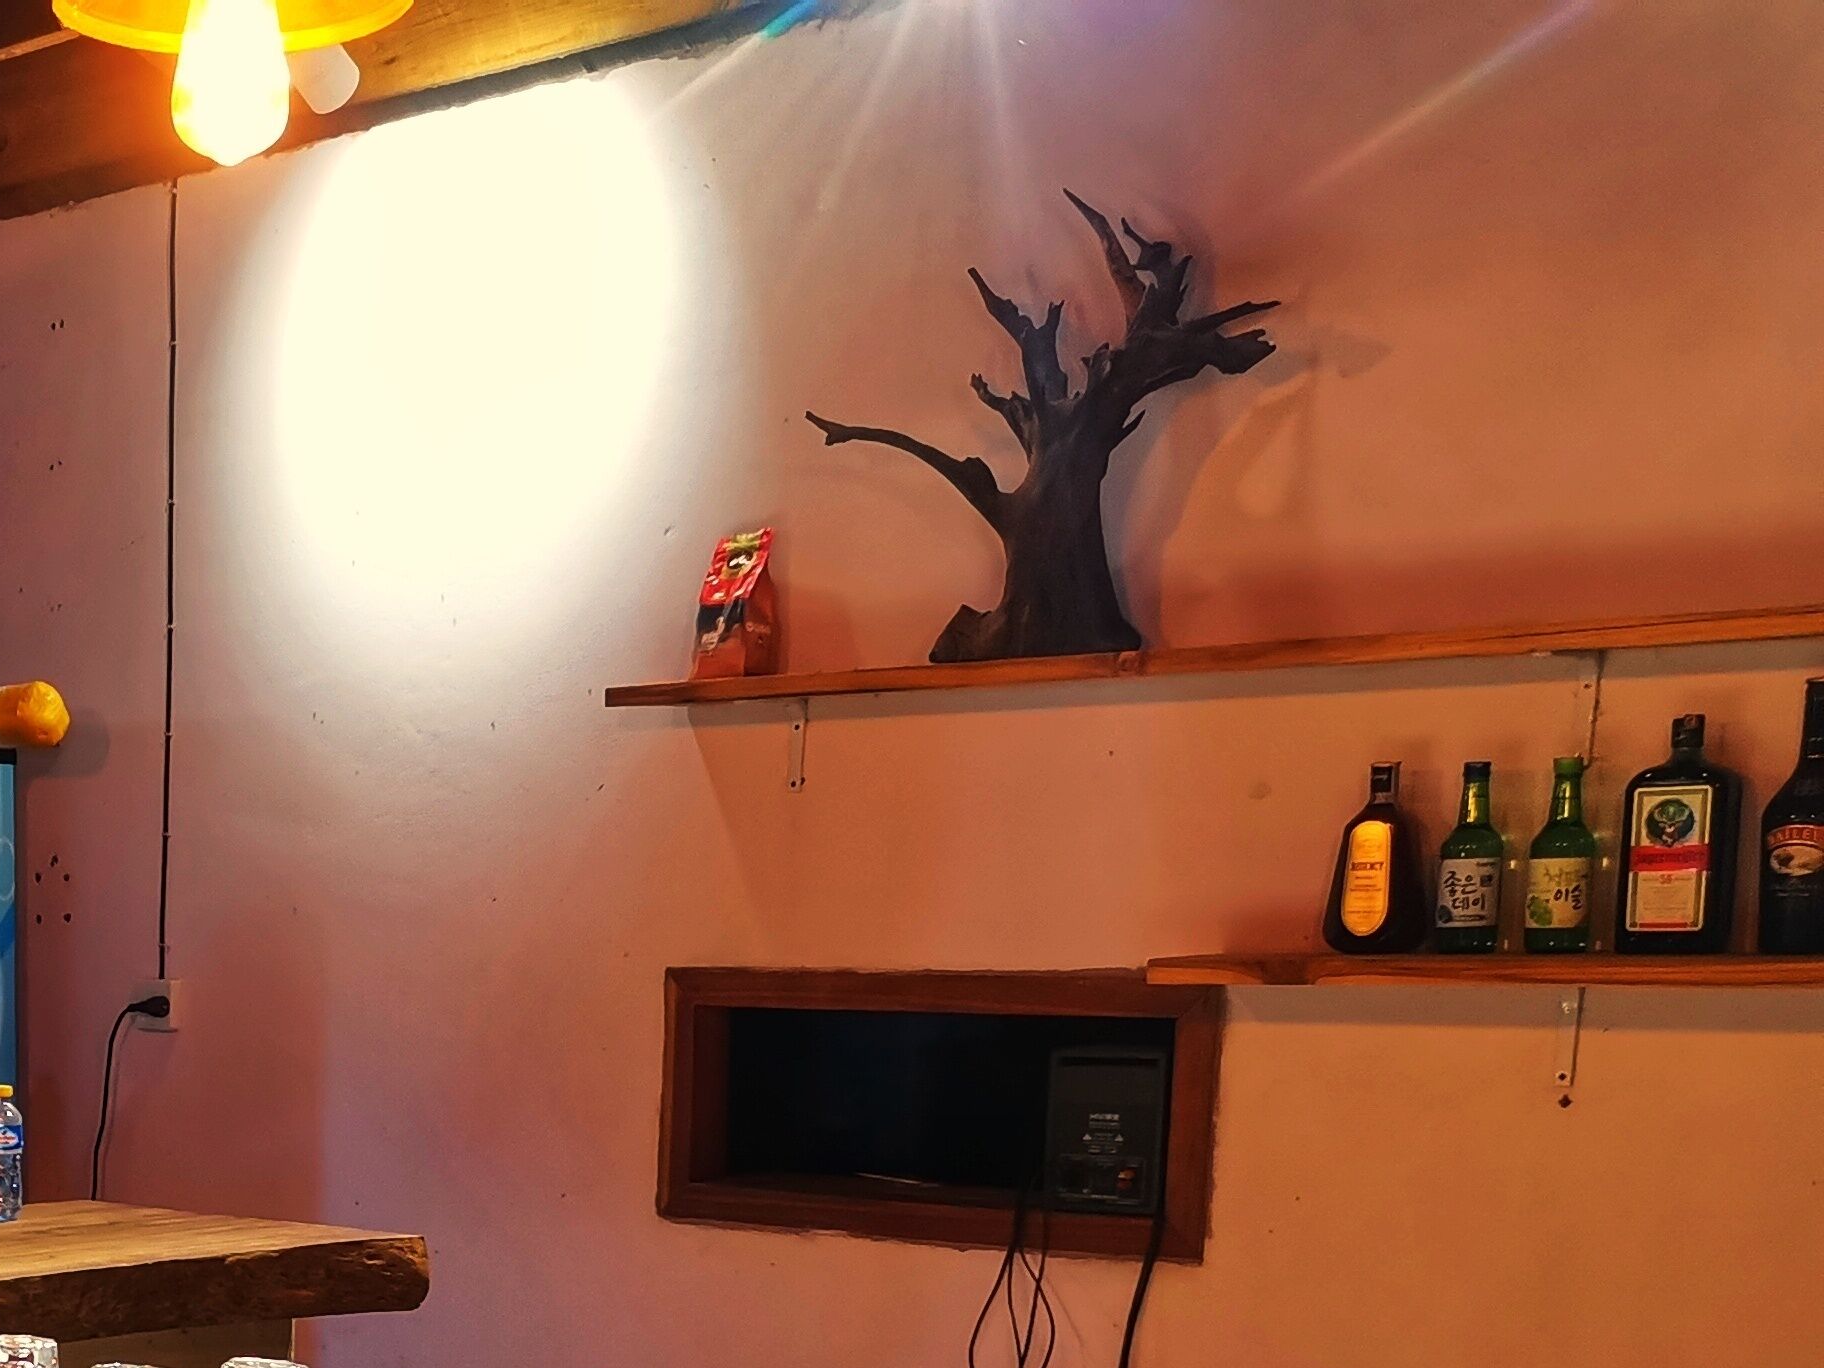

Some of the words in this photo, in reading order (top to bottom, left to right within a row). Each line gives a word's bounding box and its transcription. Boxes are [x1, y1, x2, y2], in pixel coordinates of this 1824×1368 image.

[1443, 870, 1478, 897] 좋은
[1450, 892, 1486, 911] 데이
[1553, 884, 1583, 911] 이슬
